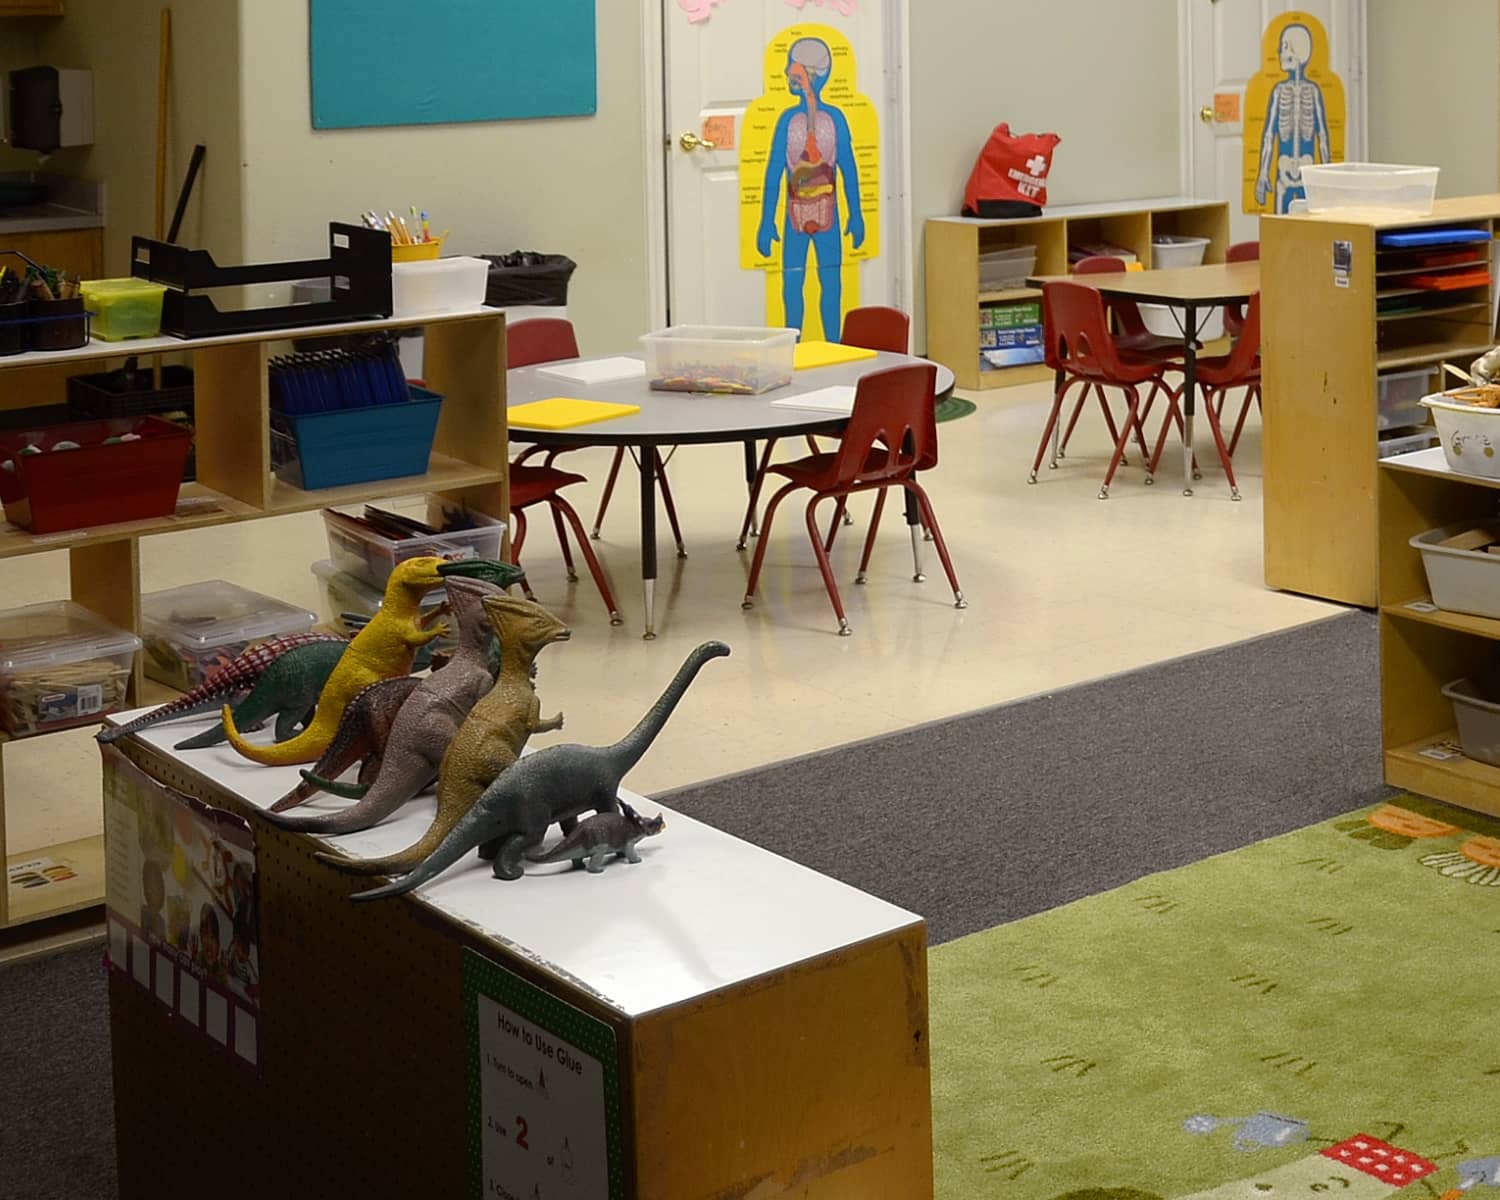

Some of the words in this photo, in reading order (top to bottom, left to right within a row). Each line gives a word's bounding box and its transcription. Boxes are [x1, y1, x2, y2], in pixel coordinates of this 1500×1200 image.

[1018, 181, 1041, 198] KIT
[497, 1012, 520, 1039] How
[521, 1028, 533, 1046] to
[535, 1035, 554, 1058] Use
[556, 1048, 583, 1075] Glue
[515, 1114, 529, 1151] 2
